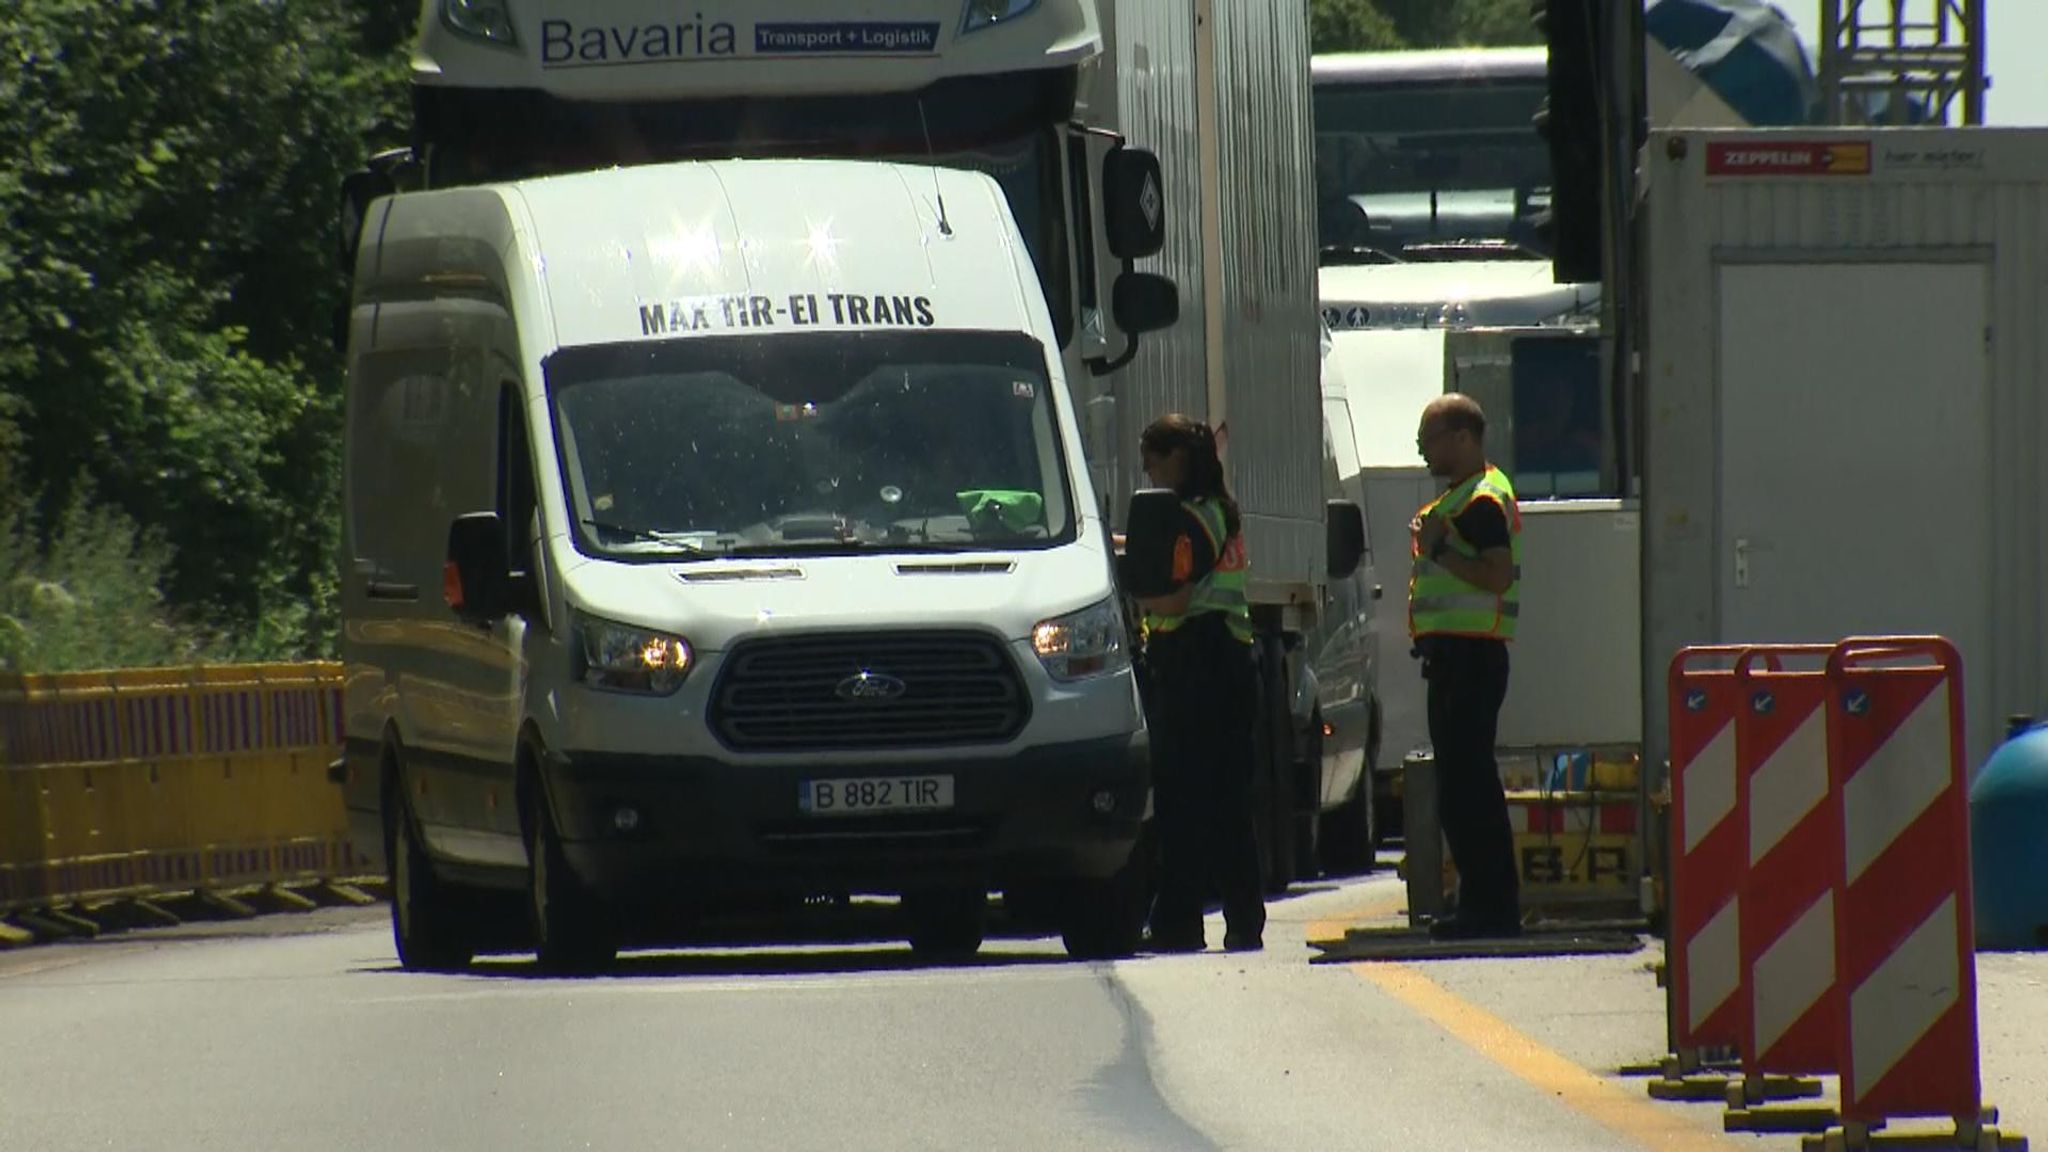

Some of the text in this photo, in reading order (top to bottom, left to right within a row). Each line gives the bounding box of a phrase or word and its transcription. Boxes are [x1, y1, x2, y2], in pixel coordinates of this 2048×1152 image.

[541, 14, 736, 63] Bavaria
[759, 30, 842, 48] Transport
[862, 29, 932, 48] Logistik
[1724, 152, 1811, 166] ZEPPELIN
[639, 301, 710, 336] MAX
[827, 294, 936, 326] TRANS
[815, 778, 940, 809] B 882 TIR
